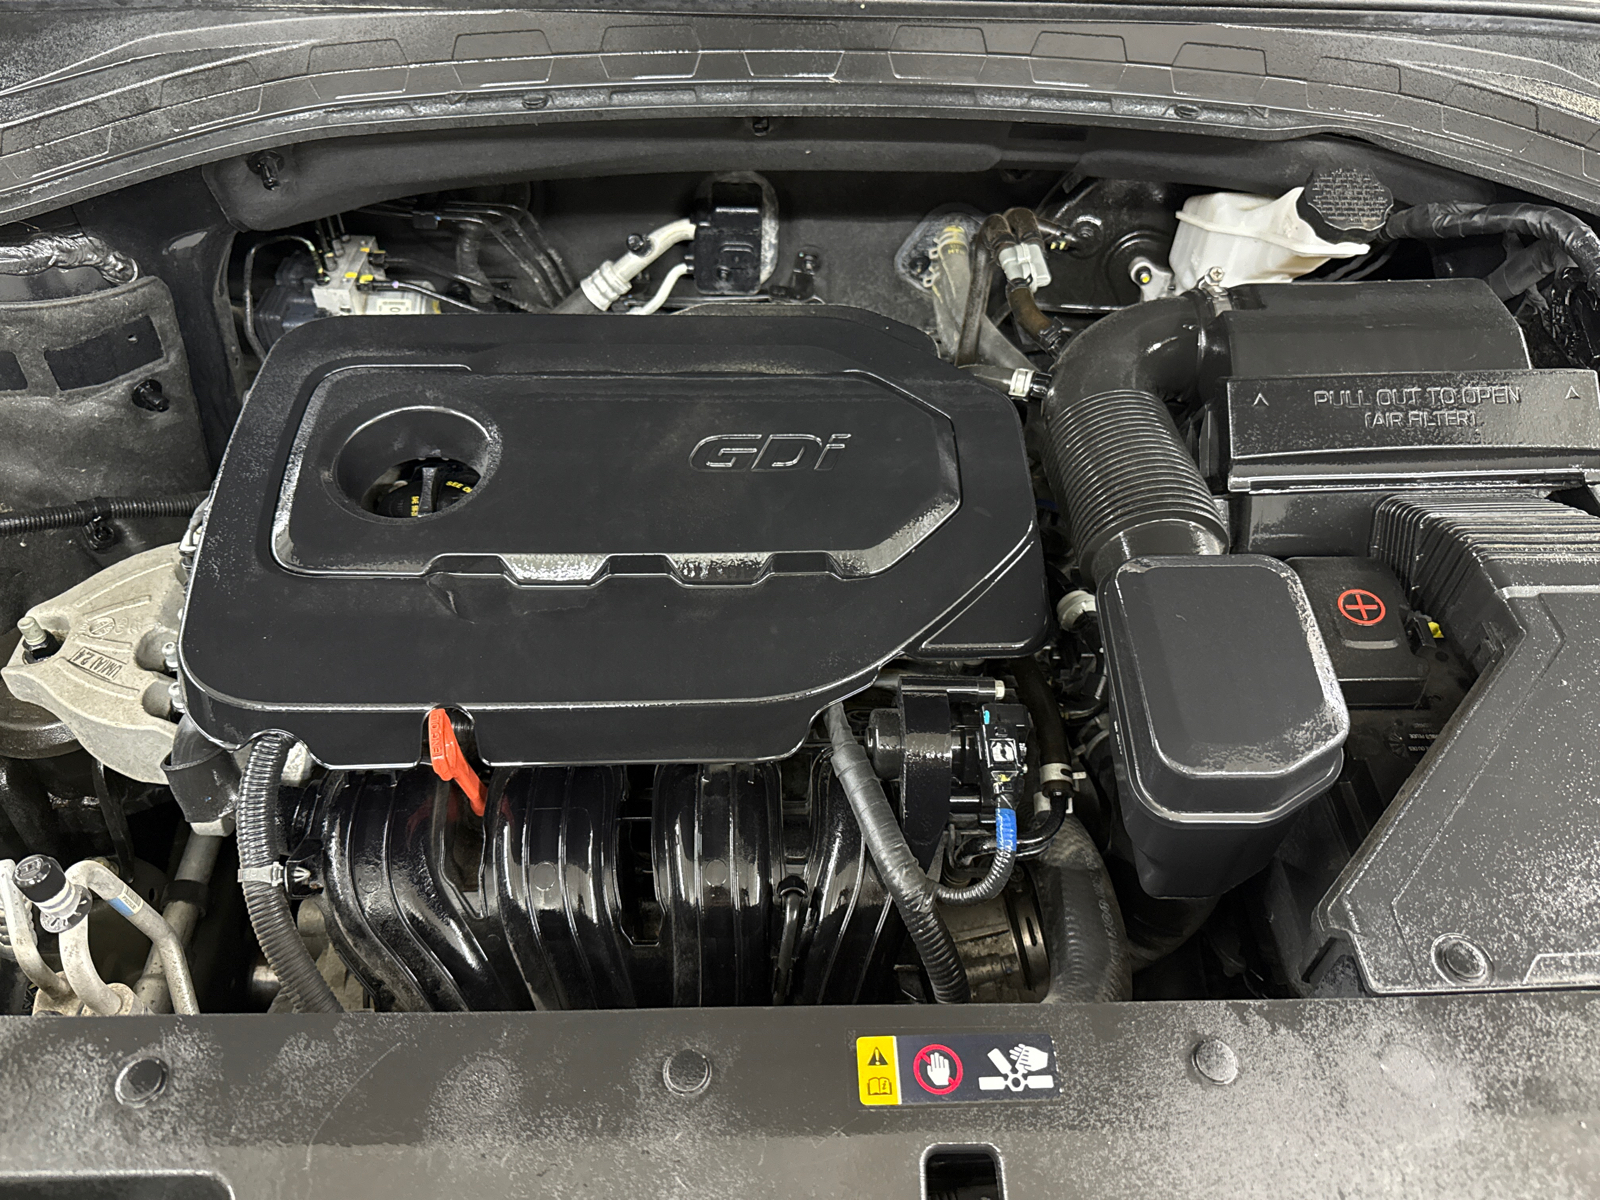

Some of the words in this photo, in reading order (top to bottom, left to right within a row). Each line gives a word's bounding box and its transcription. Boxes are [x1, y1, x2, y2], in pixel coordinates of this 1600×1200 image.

[1313, 389, 1372, 408] PULL
[1376, 387, 1422, 407] OUT
[1426, 386, 1457, 405] TO
[1461, 385, 1522, 405] OPEN
[688, 433, 852, 472] GDi
[430, 713, 441, 730] OIL
[430, 732, 442, 755] ENG
